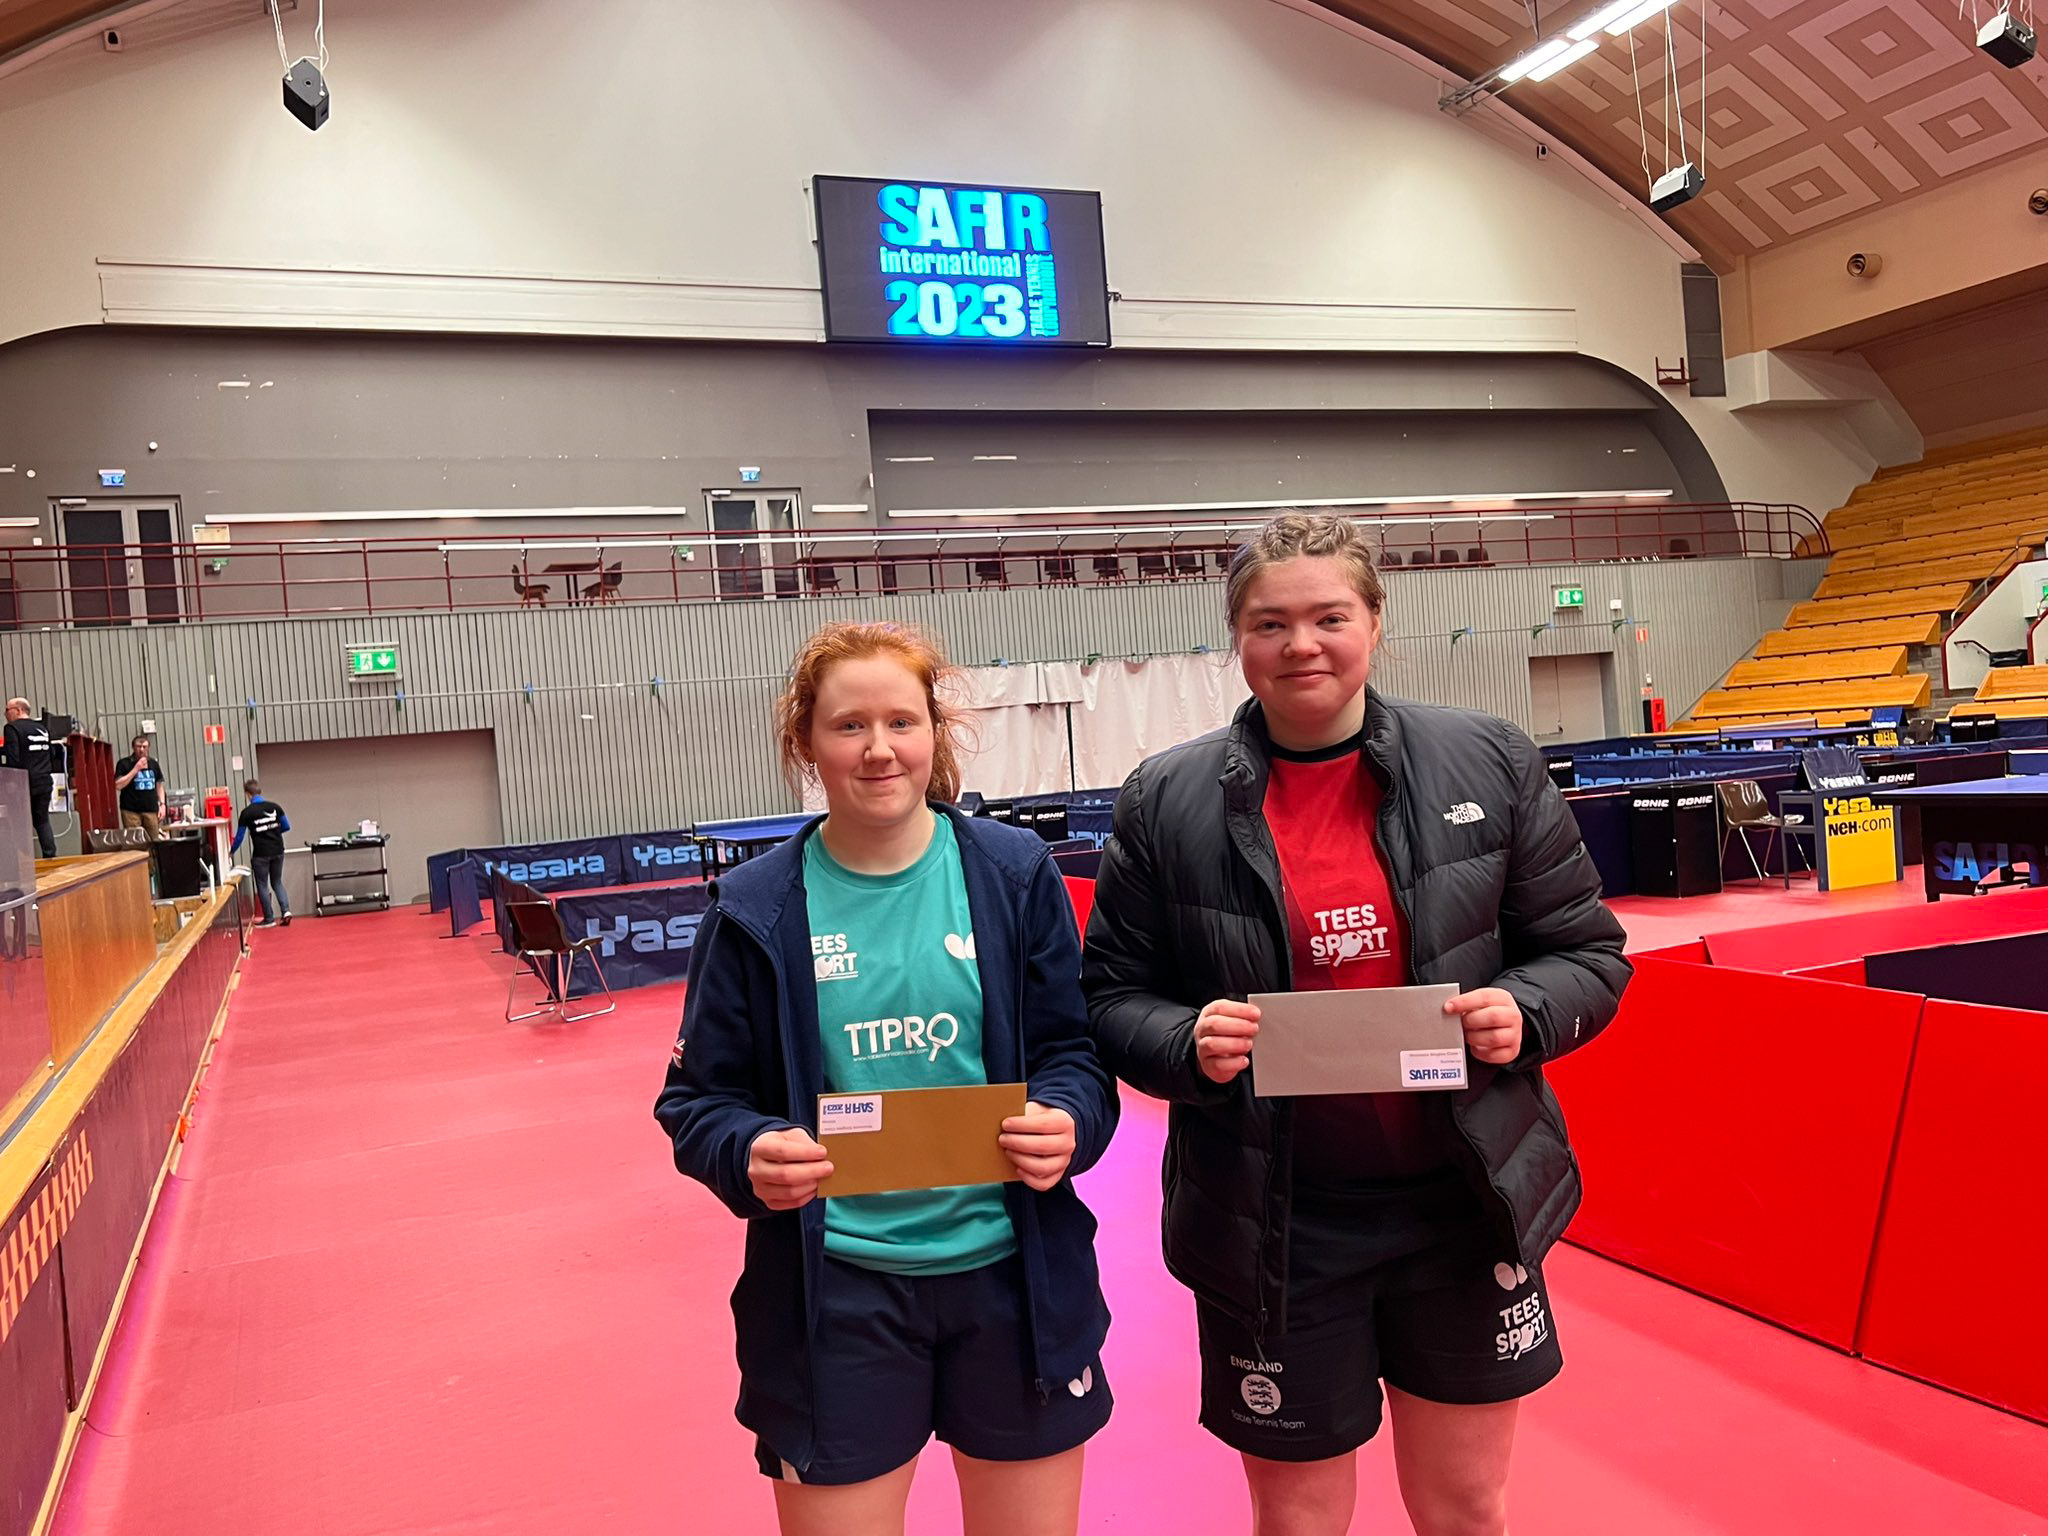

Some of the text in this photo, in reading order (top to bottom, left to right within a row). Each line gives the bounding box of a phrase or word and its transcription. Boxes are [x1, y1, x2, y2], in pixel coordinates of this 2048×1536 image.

[878, 184, 1050, 250] SAFIR
[880, 246, 1022, 277] international
[885, 280, 1026, 338] 2023
[1878, 772, 1915, 784] DONIC
[1633, 799, 1670, 808] DONIC
[1677, 795, 1713, 807] DONIC
[1823, 797, 1893, 816] Yasa
[1314, 904, 1377, 932] TEES
[586, 912, 704, 957] Yas
[811, 933, 848, 955] EES
[1310, 927, 1388, 963] SPORT
[843, 1012, 958, 1062] TTPRO
[1409, 1068, 1439, 1080] SAFIR
[845, 1102, 874, 1114] SAFIR
[1499, 1291, 1540, 1329] TEES
[1495, 1308, 1545, 1358] SPORT
[1230, 1354, 1283, 1373] ENGLAND
[1279, 1419, 1306, 1429] Team
